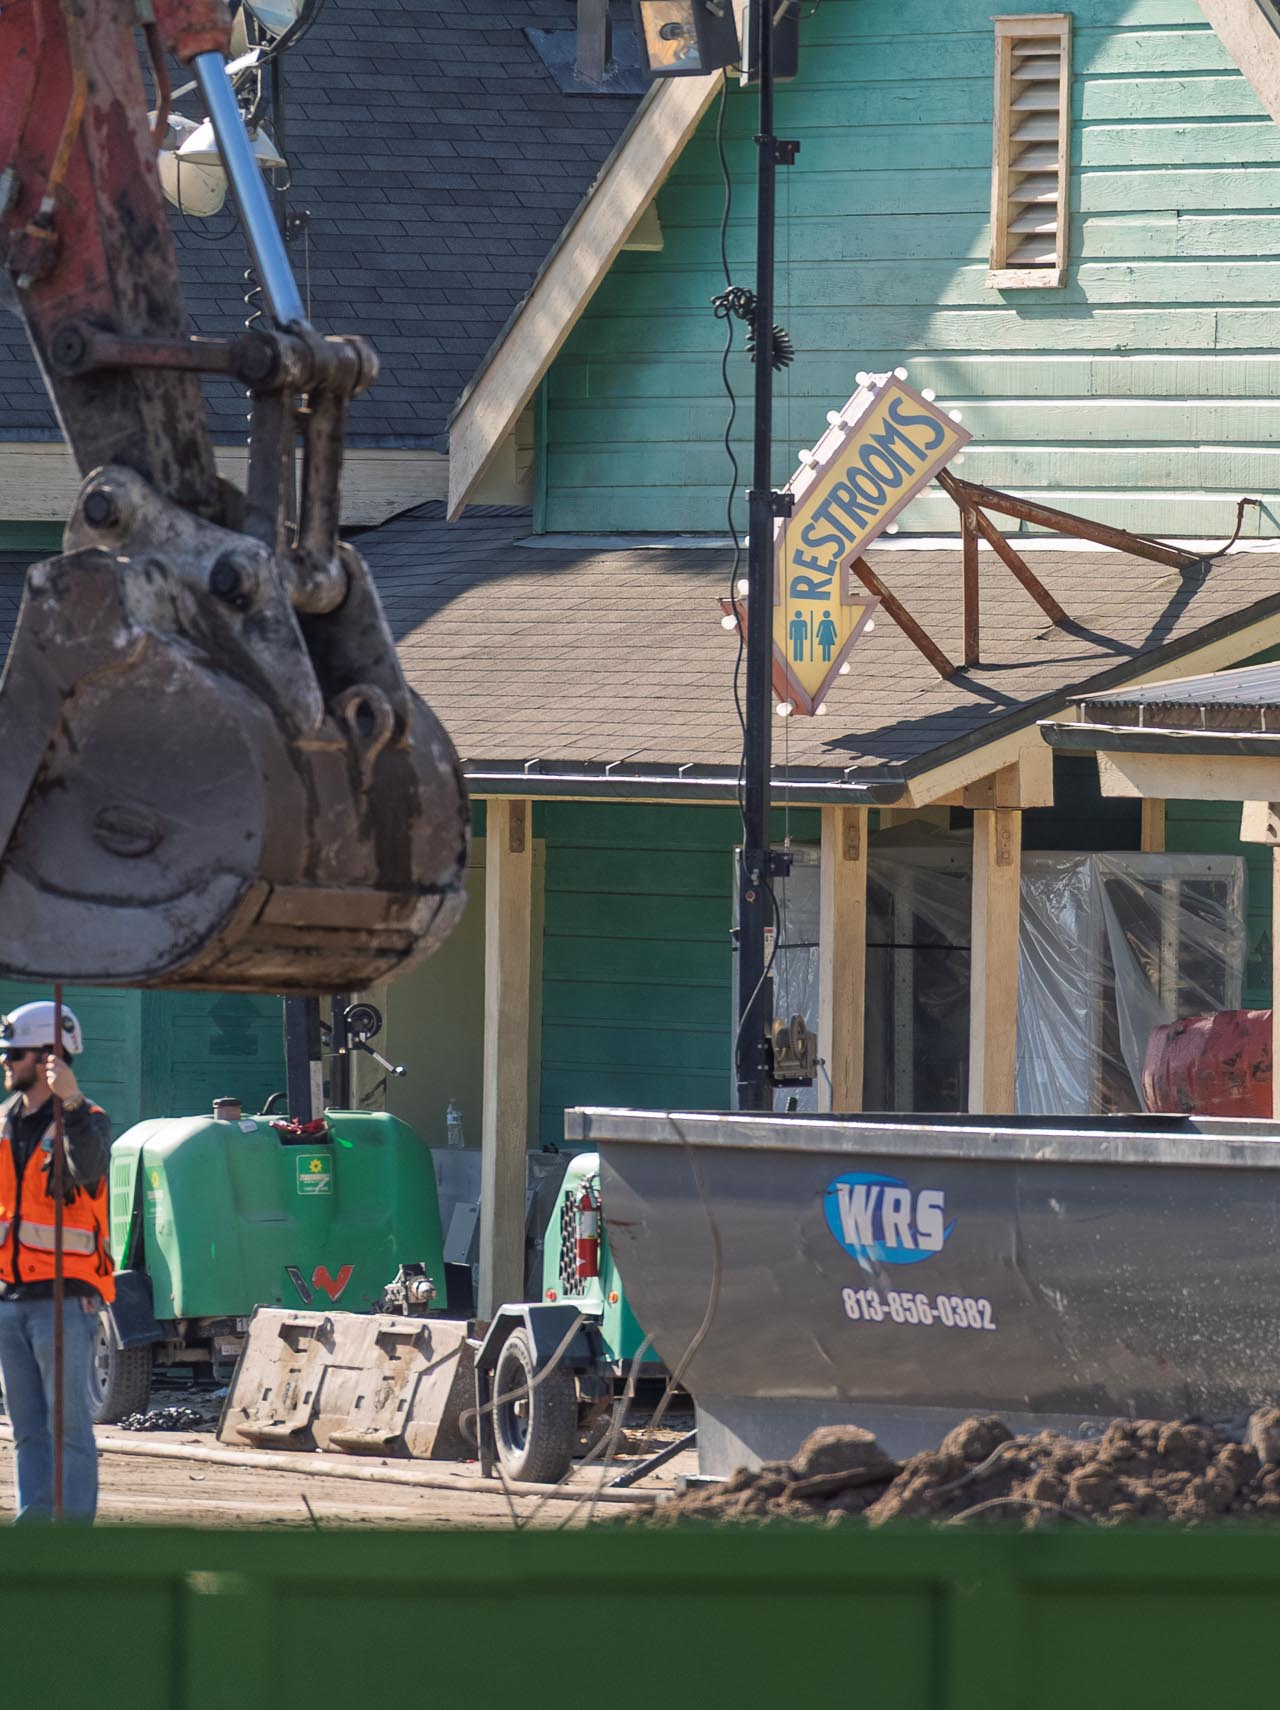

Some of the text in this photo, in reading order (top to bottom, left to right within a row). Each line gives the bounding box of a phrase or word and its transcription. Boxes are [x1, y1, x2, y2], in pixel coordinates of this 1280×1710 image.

[789, 396, 945, 600] RESTROOMS
[836, 1182, 945, 1251] WRS
[842, 1287, 997, 1331] 813-856-0382
